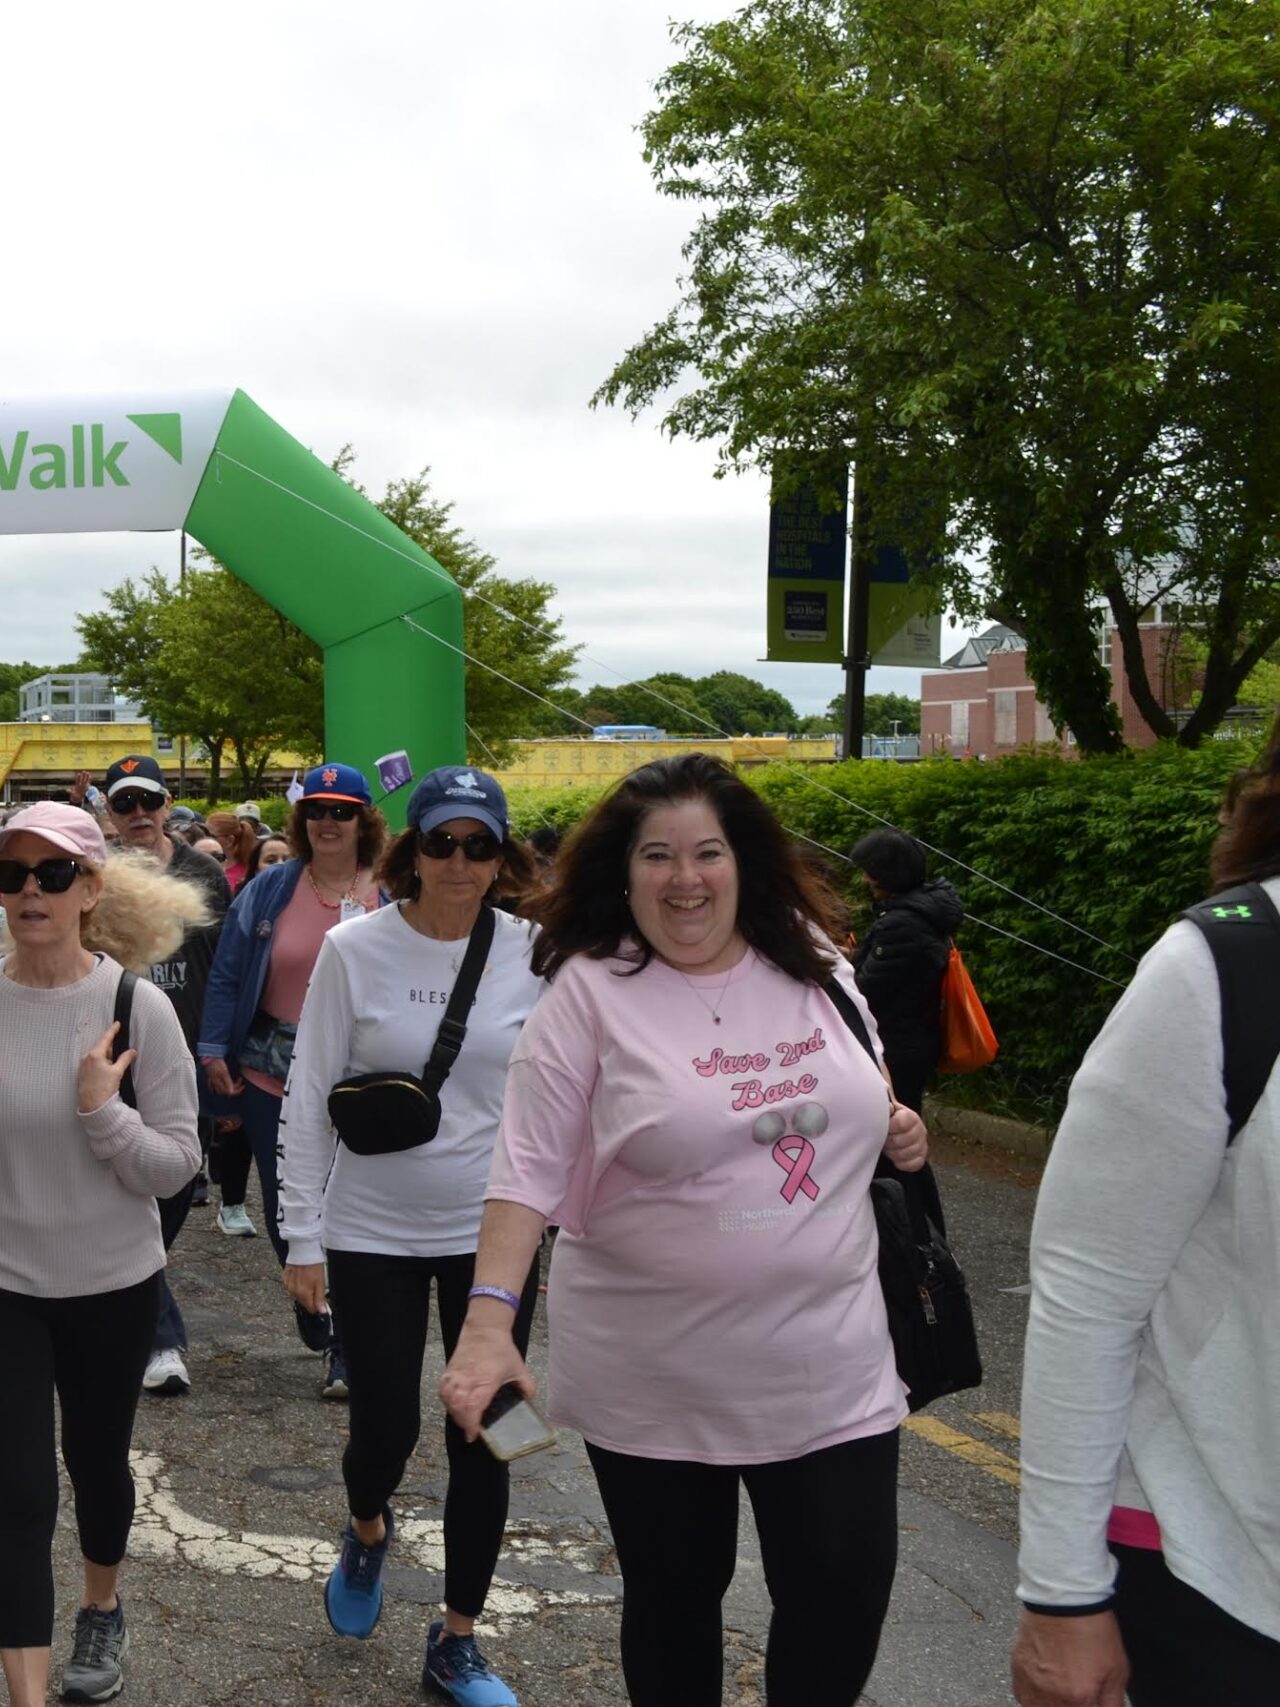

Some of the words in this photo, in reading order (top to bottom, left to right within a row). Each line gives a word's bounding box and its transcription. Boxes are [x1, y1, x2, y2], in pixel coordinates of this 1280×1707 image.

[692, 1047, 771, 1077] Save
[775, 1027, 826, 1067] 2nd
[731, 1073, 819, 1111] Base
